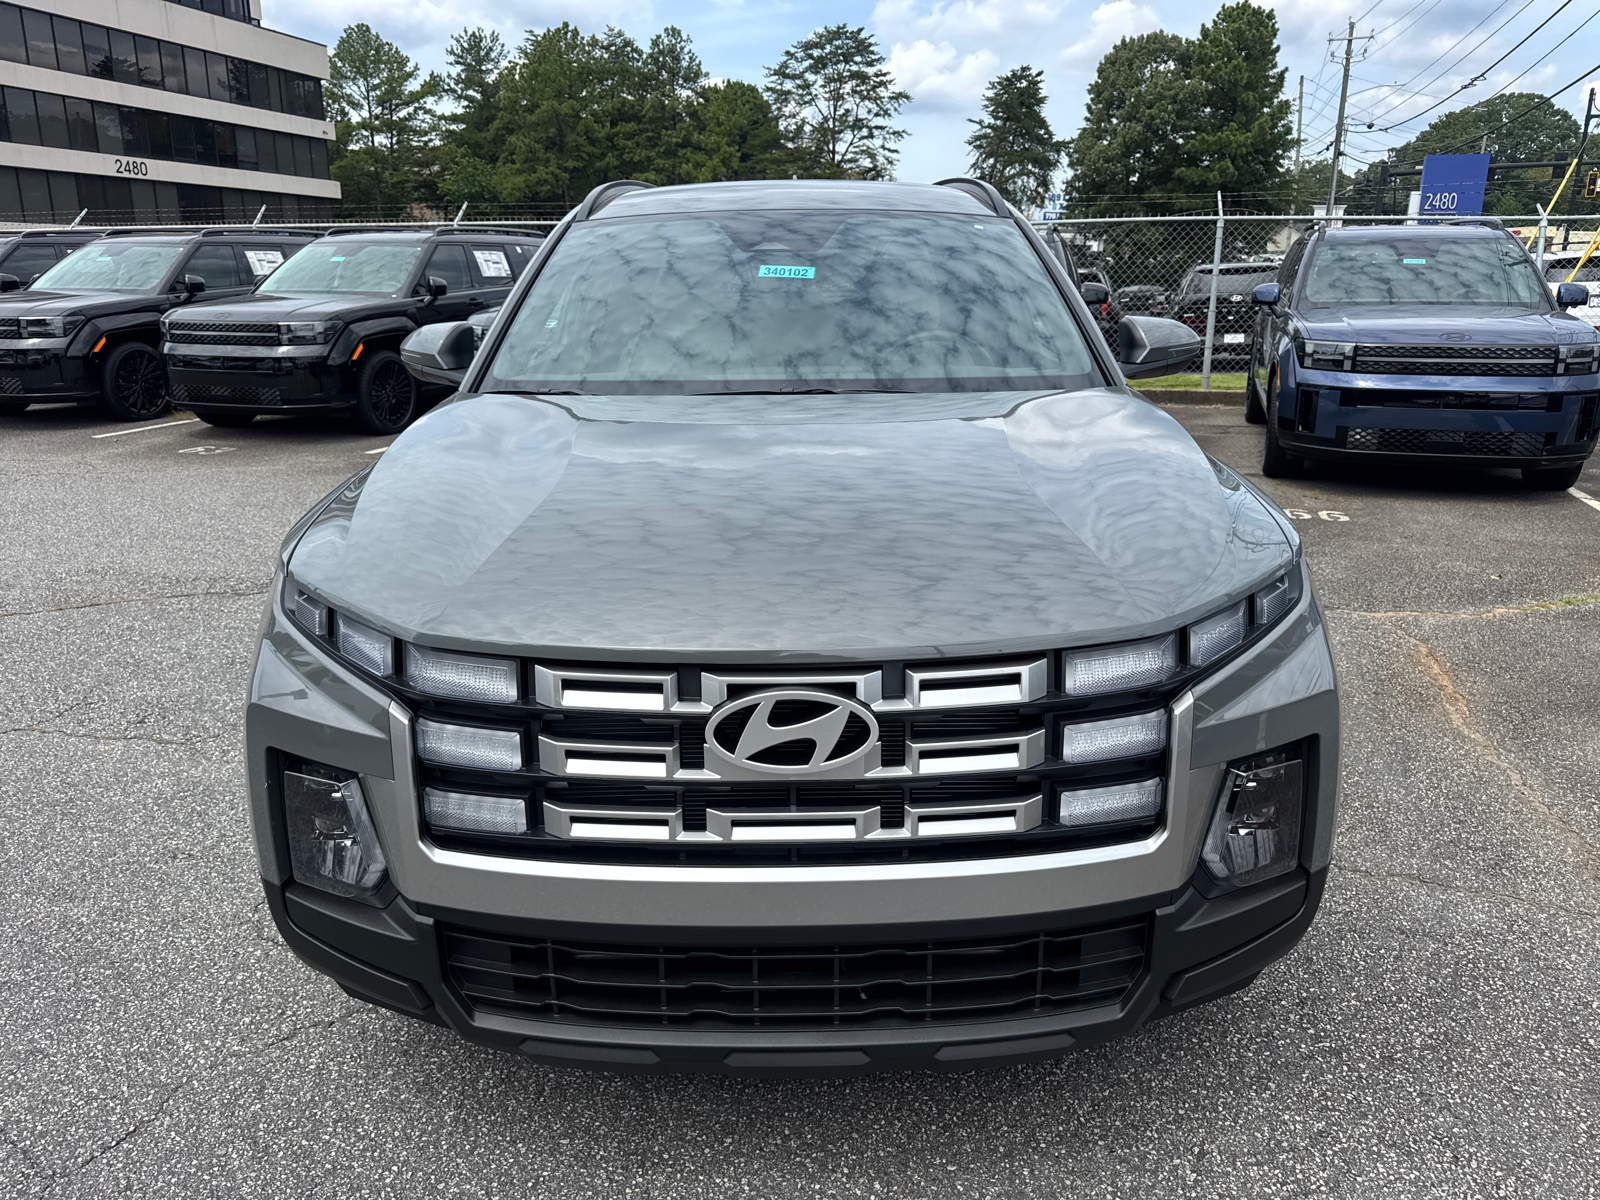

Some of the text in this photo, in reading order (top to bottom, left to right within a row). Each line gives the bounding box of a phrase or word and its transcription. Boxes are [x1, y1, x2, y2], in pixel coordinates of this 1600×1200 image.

[114, 158, 148, 176] 2480
[1423, 192, 1458, 210] 2480
[763, 267, 809, 277] 340102
[1282, 508, 1350, 521] 66
